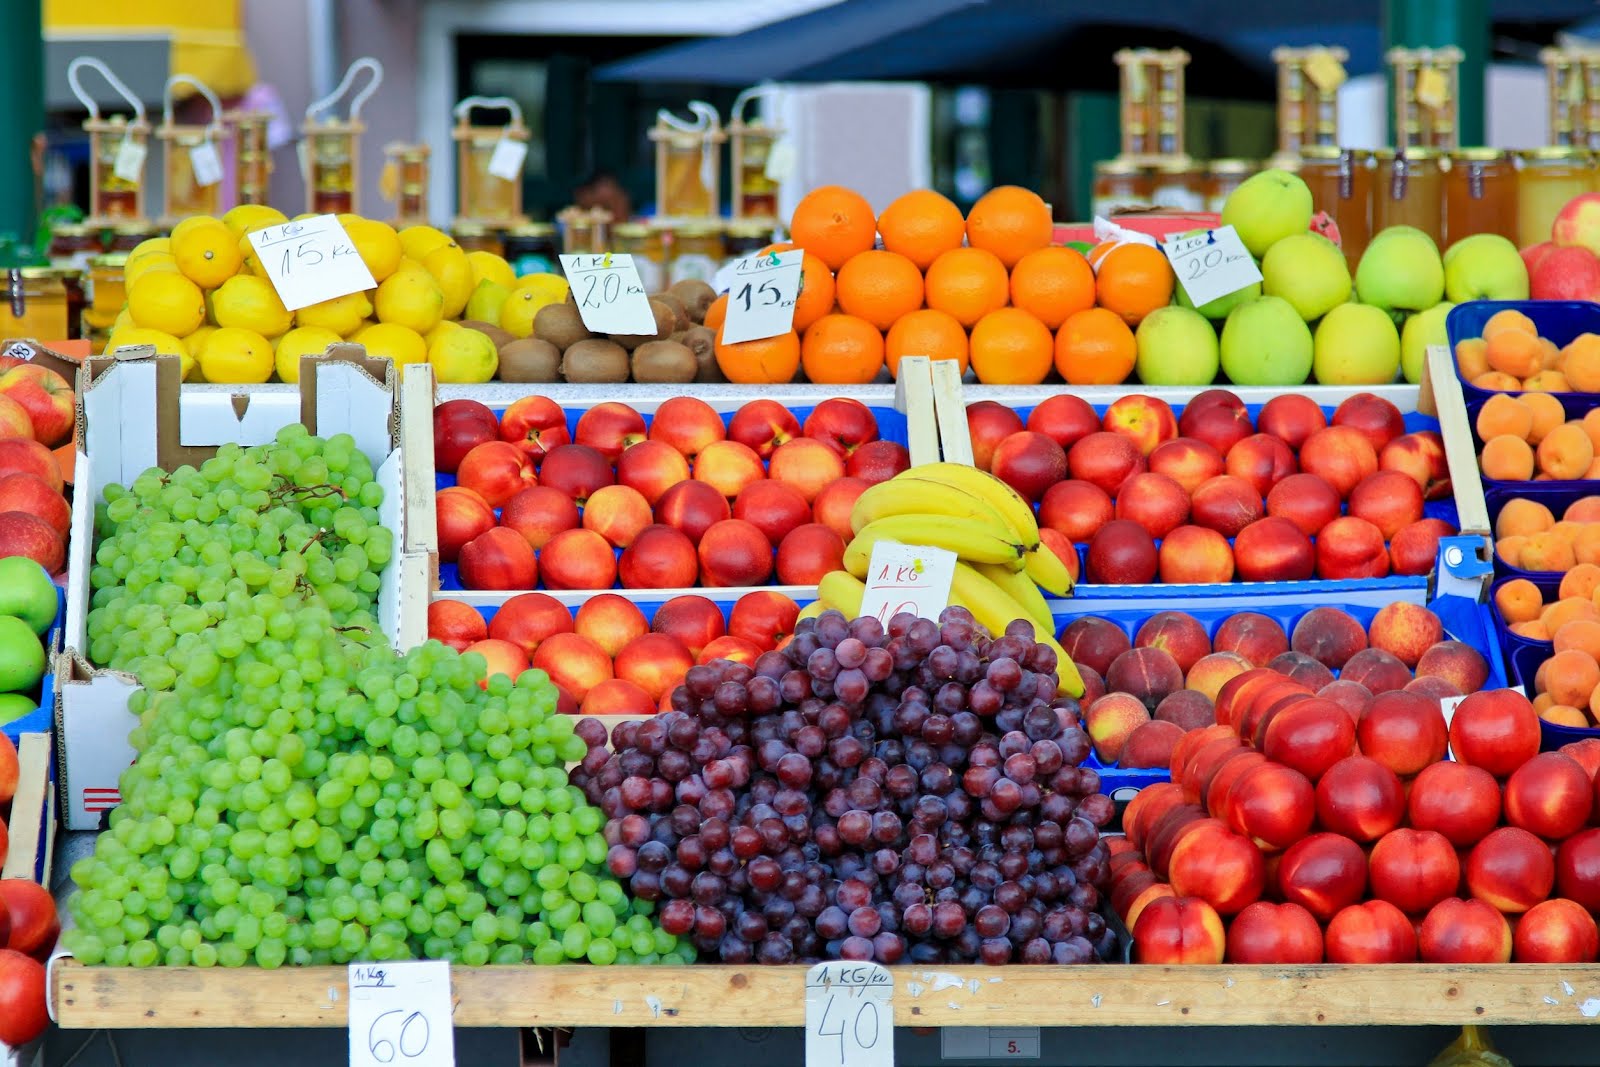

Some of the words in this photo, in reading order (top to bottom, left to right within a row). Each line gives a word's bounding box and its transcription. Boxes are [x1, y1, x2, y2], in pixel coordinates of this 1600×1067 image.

[281, 239, 324, 277] 15
[1188, 249, 1223, 280] 20
[582, 272, 621, 309] 20
[736, 278, 781, 312] 15
[895, 566, 918, 583] KG
[369, 1009, 430, 1063] 60
[818, 994, 879, 1065] 40
[1007, 1040, 1021, 1054] 5.
